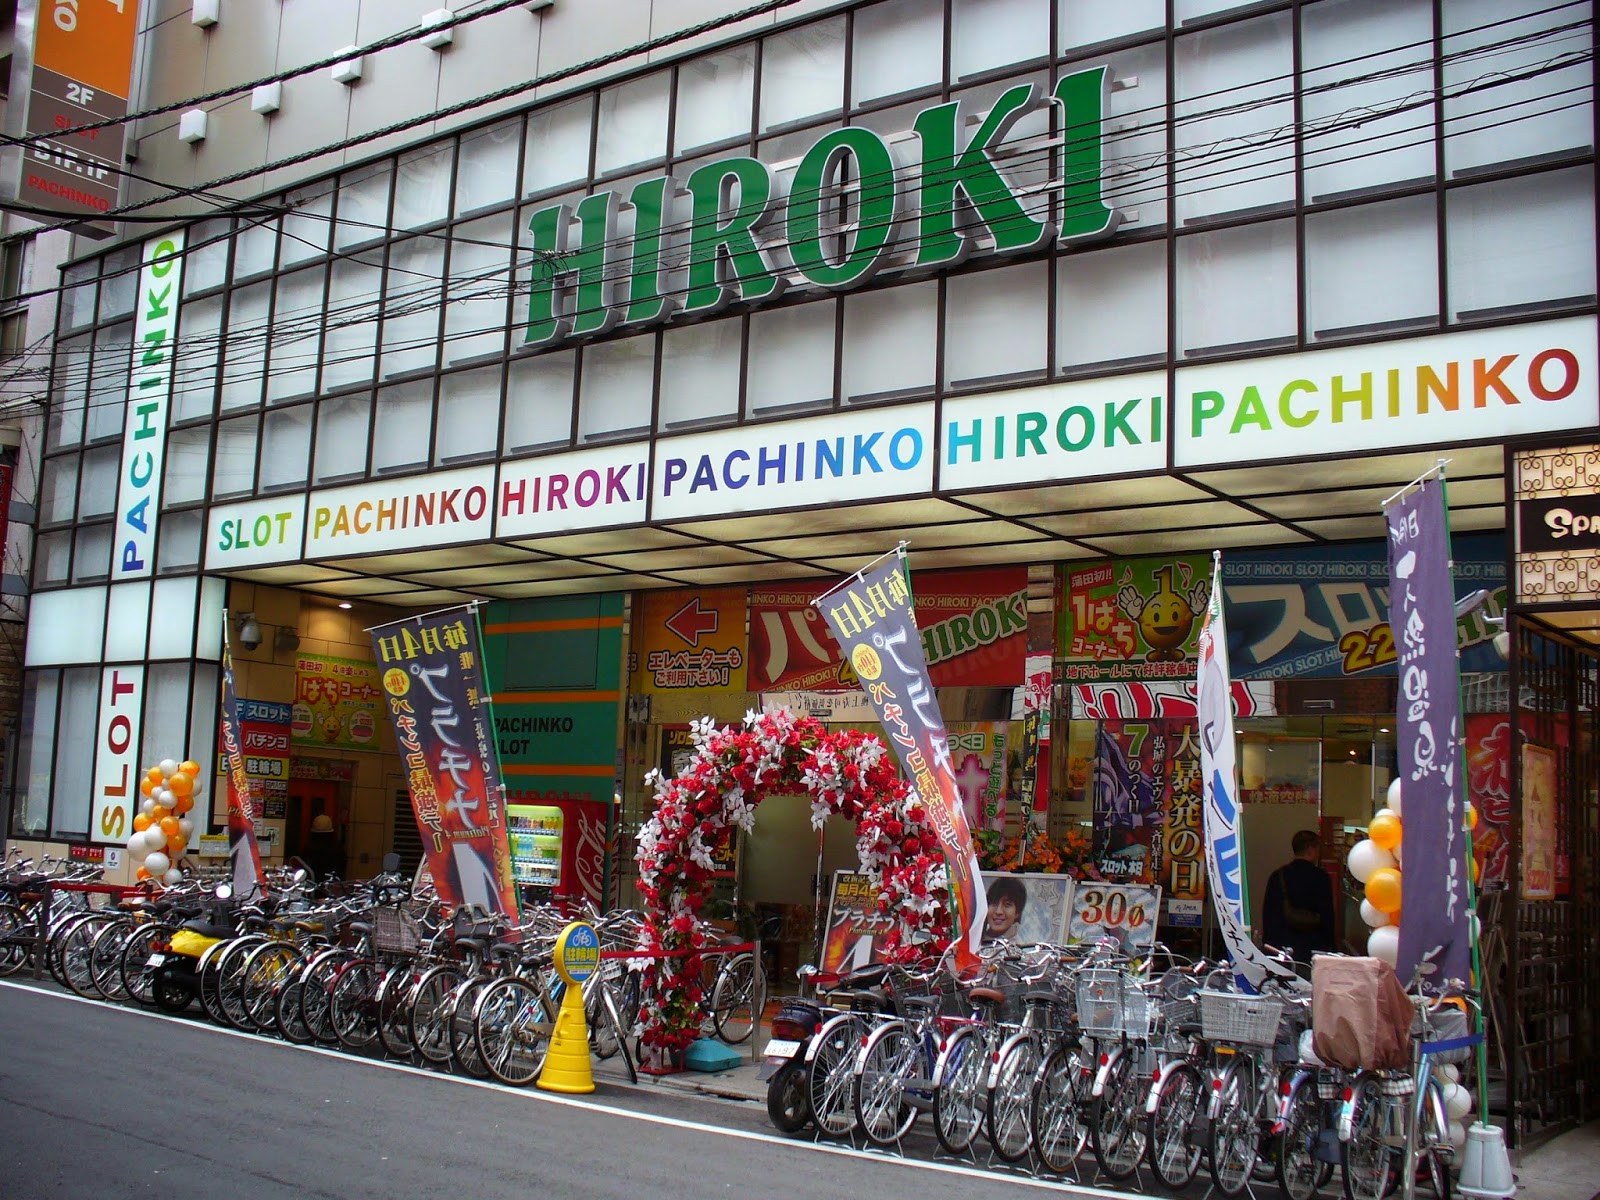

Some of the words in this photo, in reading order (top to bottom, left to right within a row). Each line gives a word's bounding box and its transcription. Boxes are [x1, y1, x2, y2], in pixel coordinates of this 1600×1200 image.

[66, 83, 94, 105] 2F
[28, 175, 110, 211] PACHINKO
[522, 64, 1124, 348] HIROKI
[122, 239, 175, 572] PACHINKO
[219, 511, 292, 551] SLOT
[313, 485, 487, 539] PACHINKO
[501, 462, 646, 517] HIROKI
[663, 427, 922, 497] PACHINKO
[948, 396, 1162, 465] HIROKI
[1191, 348, 1580, 438] PACHINKO
[1225, 564, 1250, 575] SLOT
[1254, 564, 1293, 575] HIROKI
[1295, 564, 1324, 575] SLOT
[1327, 564, 1366, 575] HIROKI
[1370, 564, 1390, 575] SLO
[1485, 565, 1505, 577] HIR
[777, 594, 805, 604] HIROKI
[937, 597, 969, 607] HIROKI
[923, 591, 1028, 664] HIROK
[648, 648, 743, 670] エレベーターも
[1295, 653, 1324, 671] SLOT
[802, 669, 831, 687] HIROKI
[247, 705, 291, 722] スロット
[245, 732, 288, 749] パチンコ
[101, 670, 135, 839] SLOT
[1100, 858, 1127, 874] スロット
